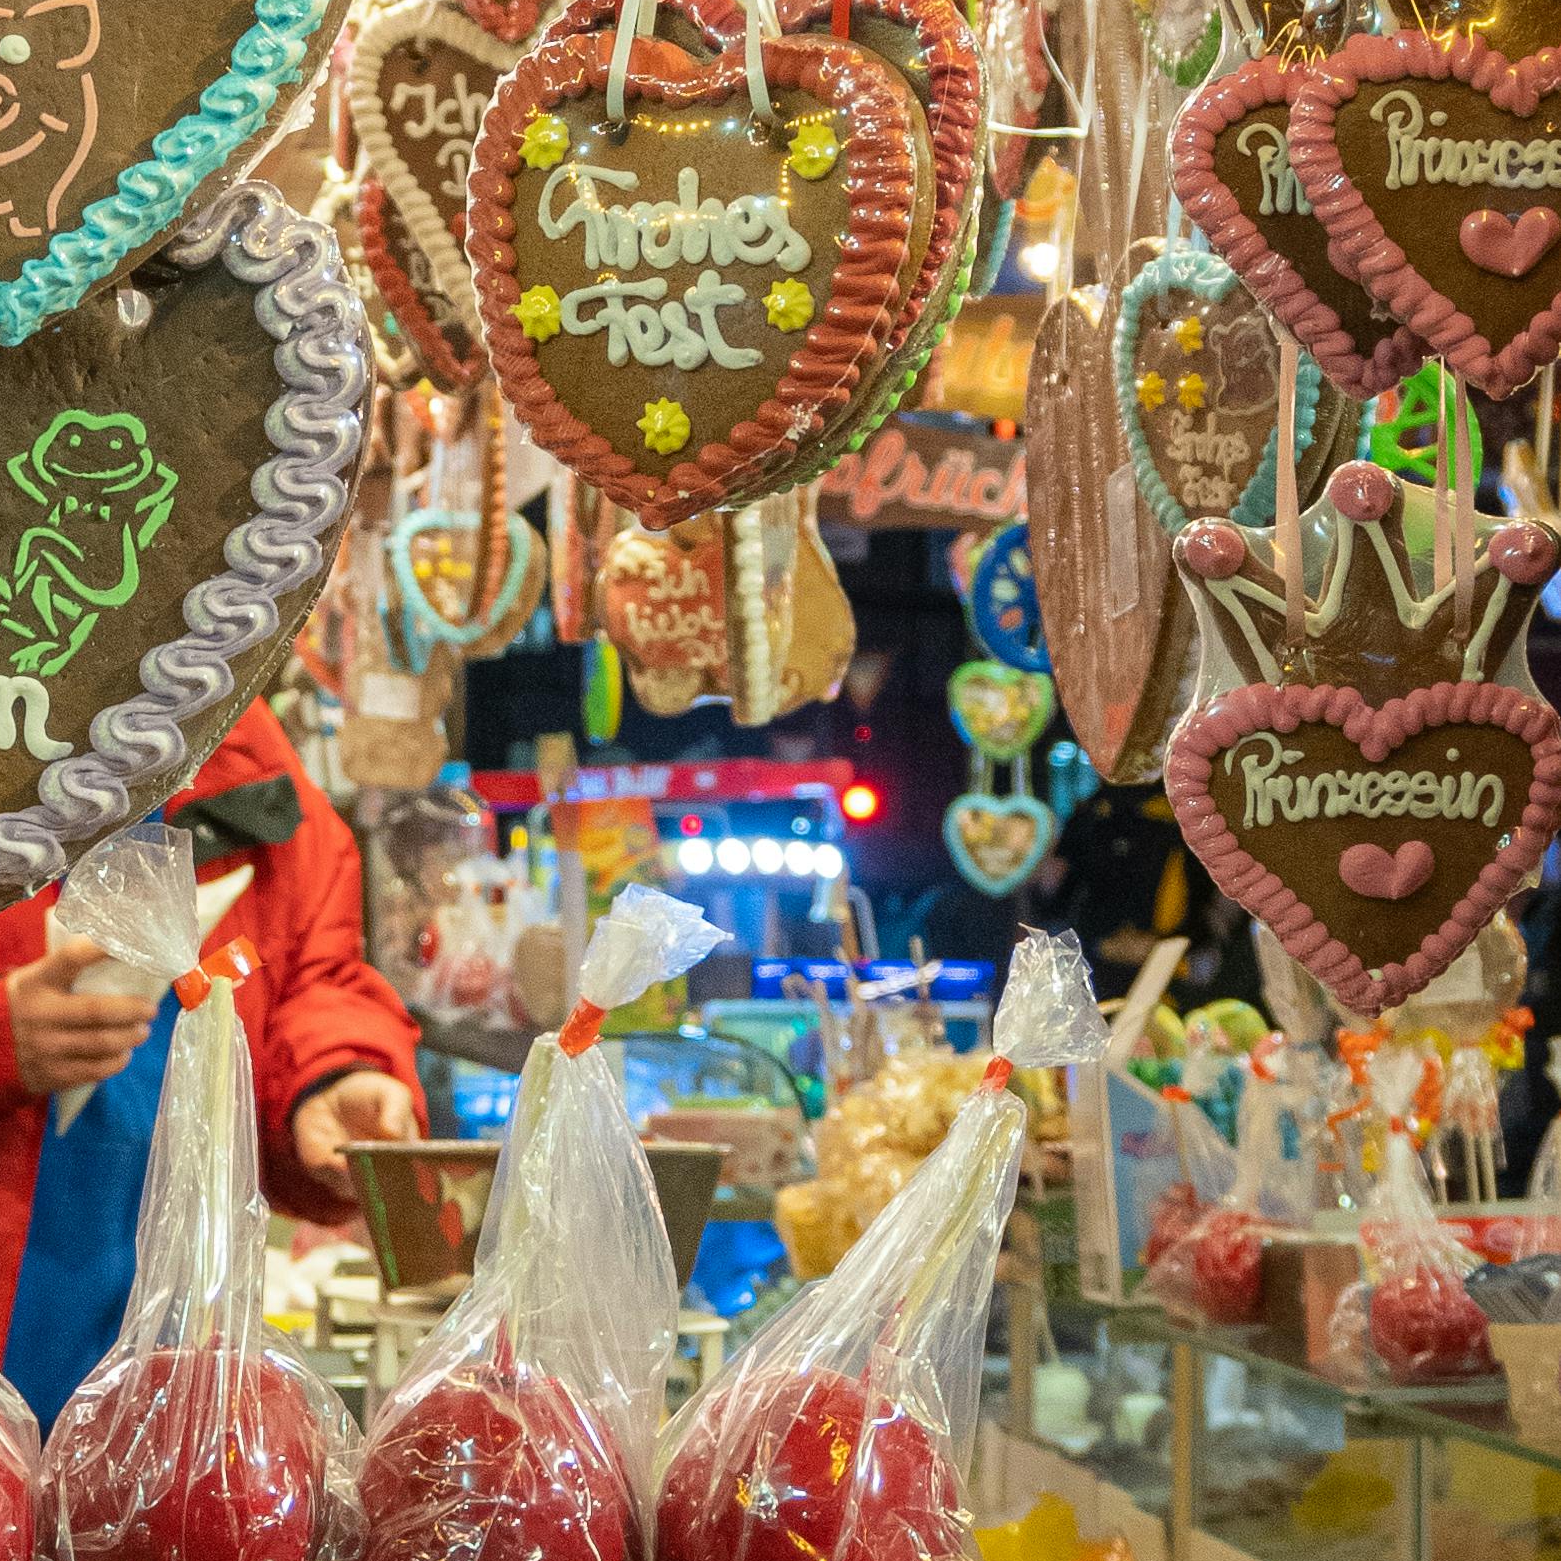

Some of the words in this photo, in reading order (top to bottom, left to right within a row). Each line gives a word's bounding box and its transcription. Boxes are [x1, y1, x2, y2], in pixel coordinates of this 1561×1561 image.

[1369, 89, 1561, 190] Prinzess
[538, 164, 813, 271] Frohes
[561, 269, 764, 371] Fest
[1225, 732, 1504, 829] Prinzessin
